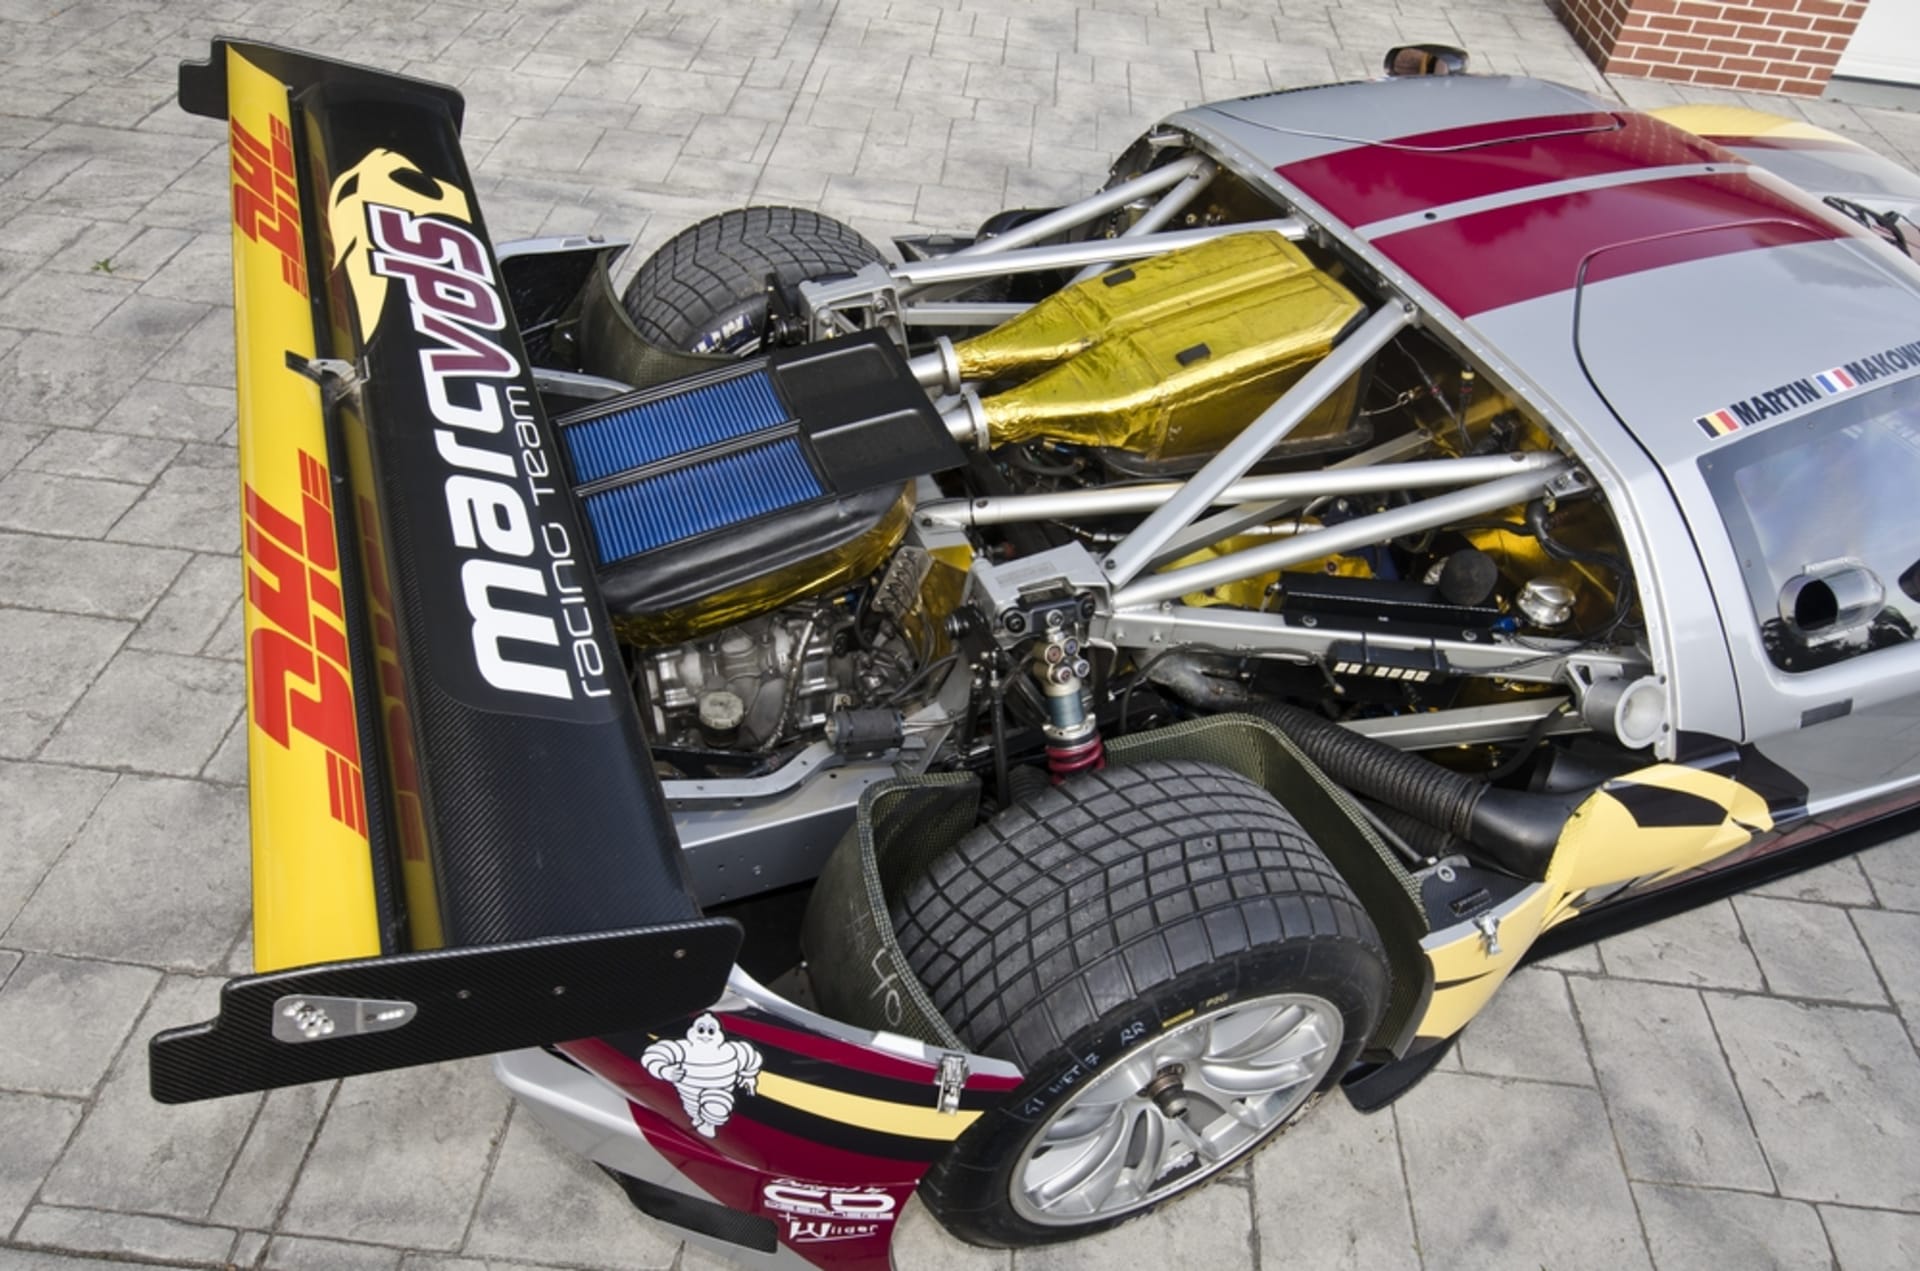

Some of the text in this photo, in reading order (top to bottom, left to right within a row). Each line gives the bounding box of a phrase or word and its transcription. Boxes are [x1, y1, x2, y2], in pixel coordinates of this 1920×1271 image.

[231, 105, 304, 271] DHL
[1730, 378, 1822, 426] MARTIN
[245, 482, 361, 771] DHL
